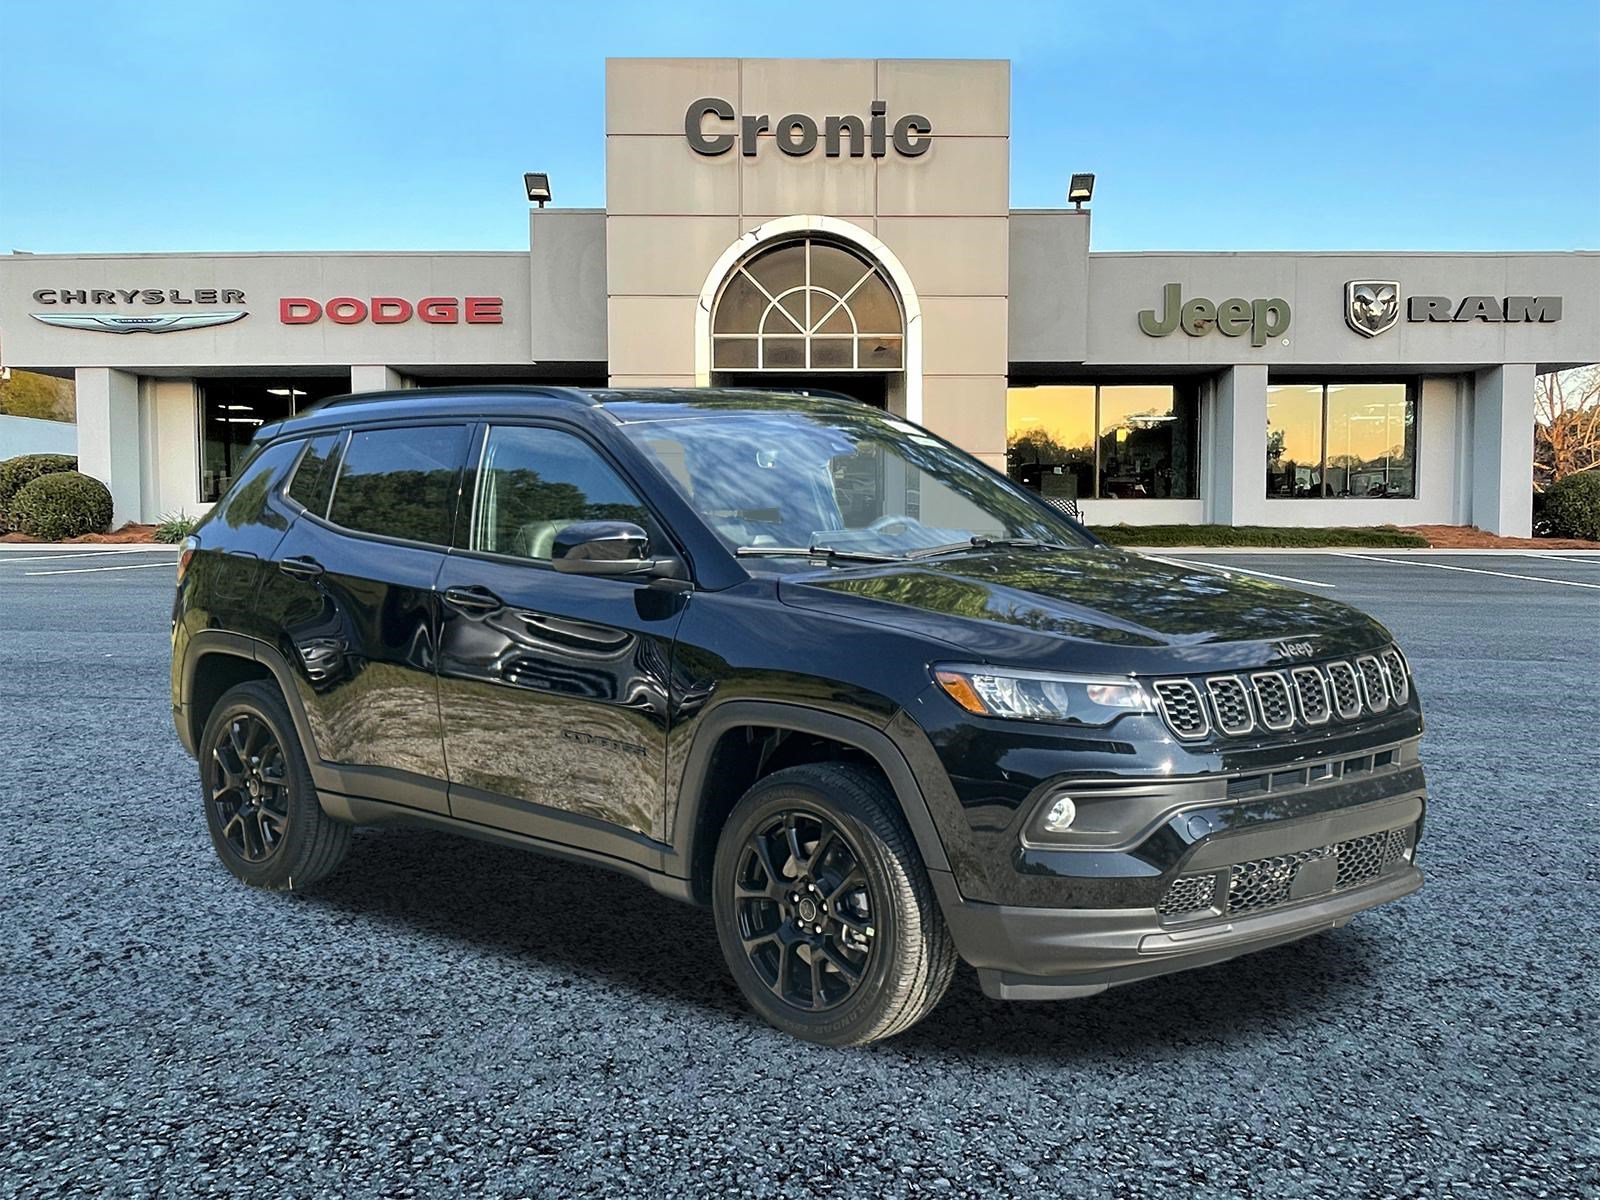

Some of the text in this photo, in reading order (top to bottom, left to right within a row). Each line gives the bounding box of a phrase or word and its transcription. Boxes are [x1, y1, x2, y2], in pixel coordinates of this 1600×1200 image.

[685, 97, 932, 157] Cronic
[32, 288, 246, 305] CHRYSLER
[1406, 296, 1563, 323] RAM
[279, 297, 503, 325] DODGE
[1138, 283, 1291, 347] Jeep
[1279, 641, 1313, 657] Jeep
